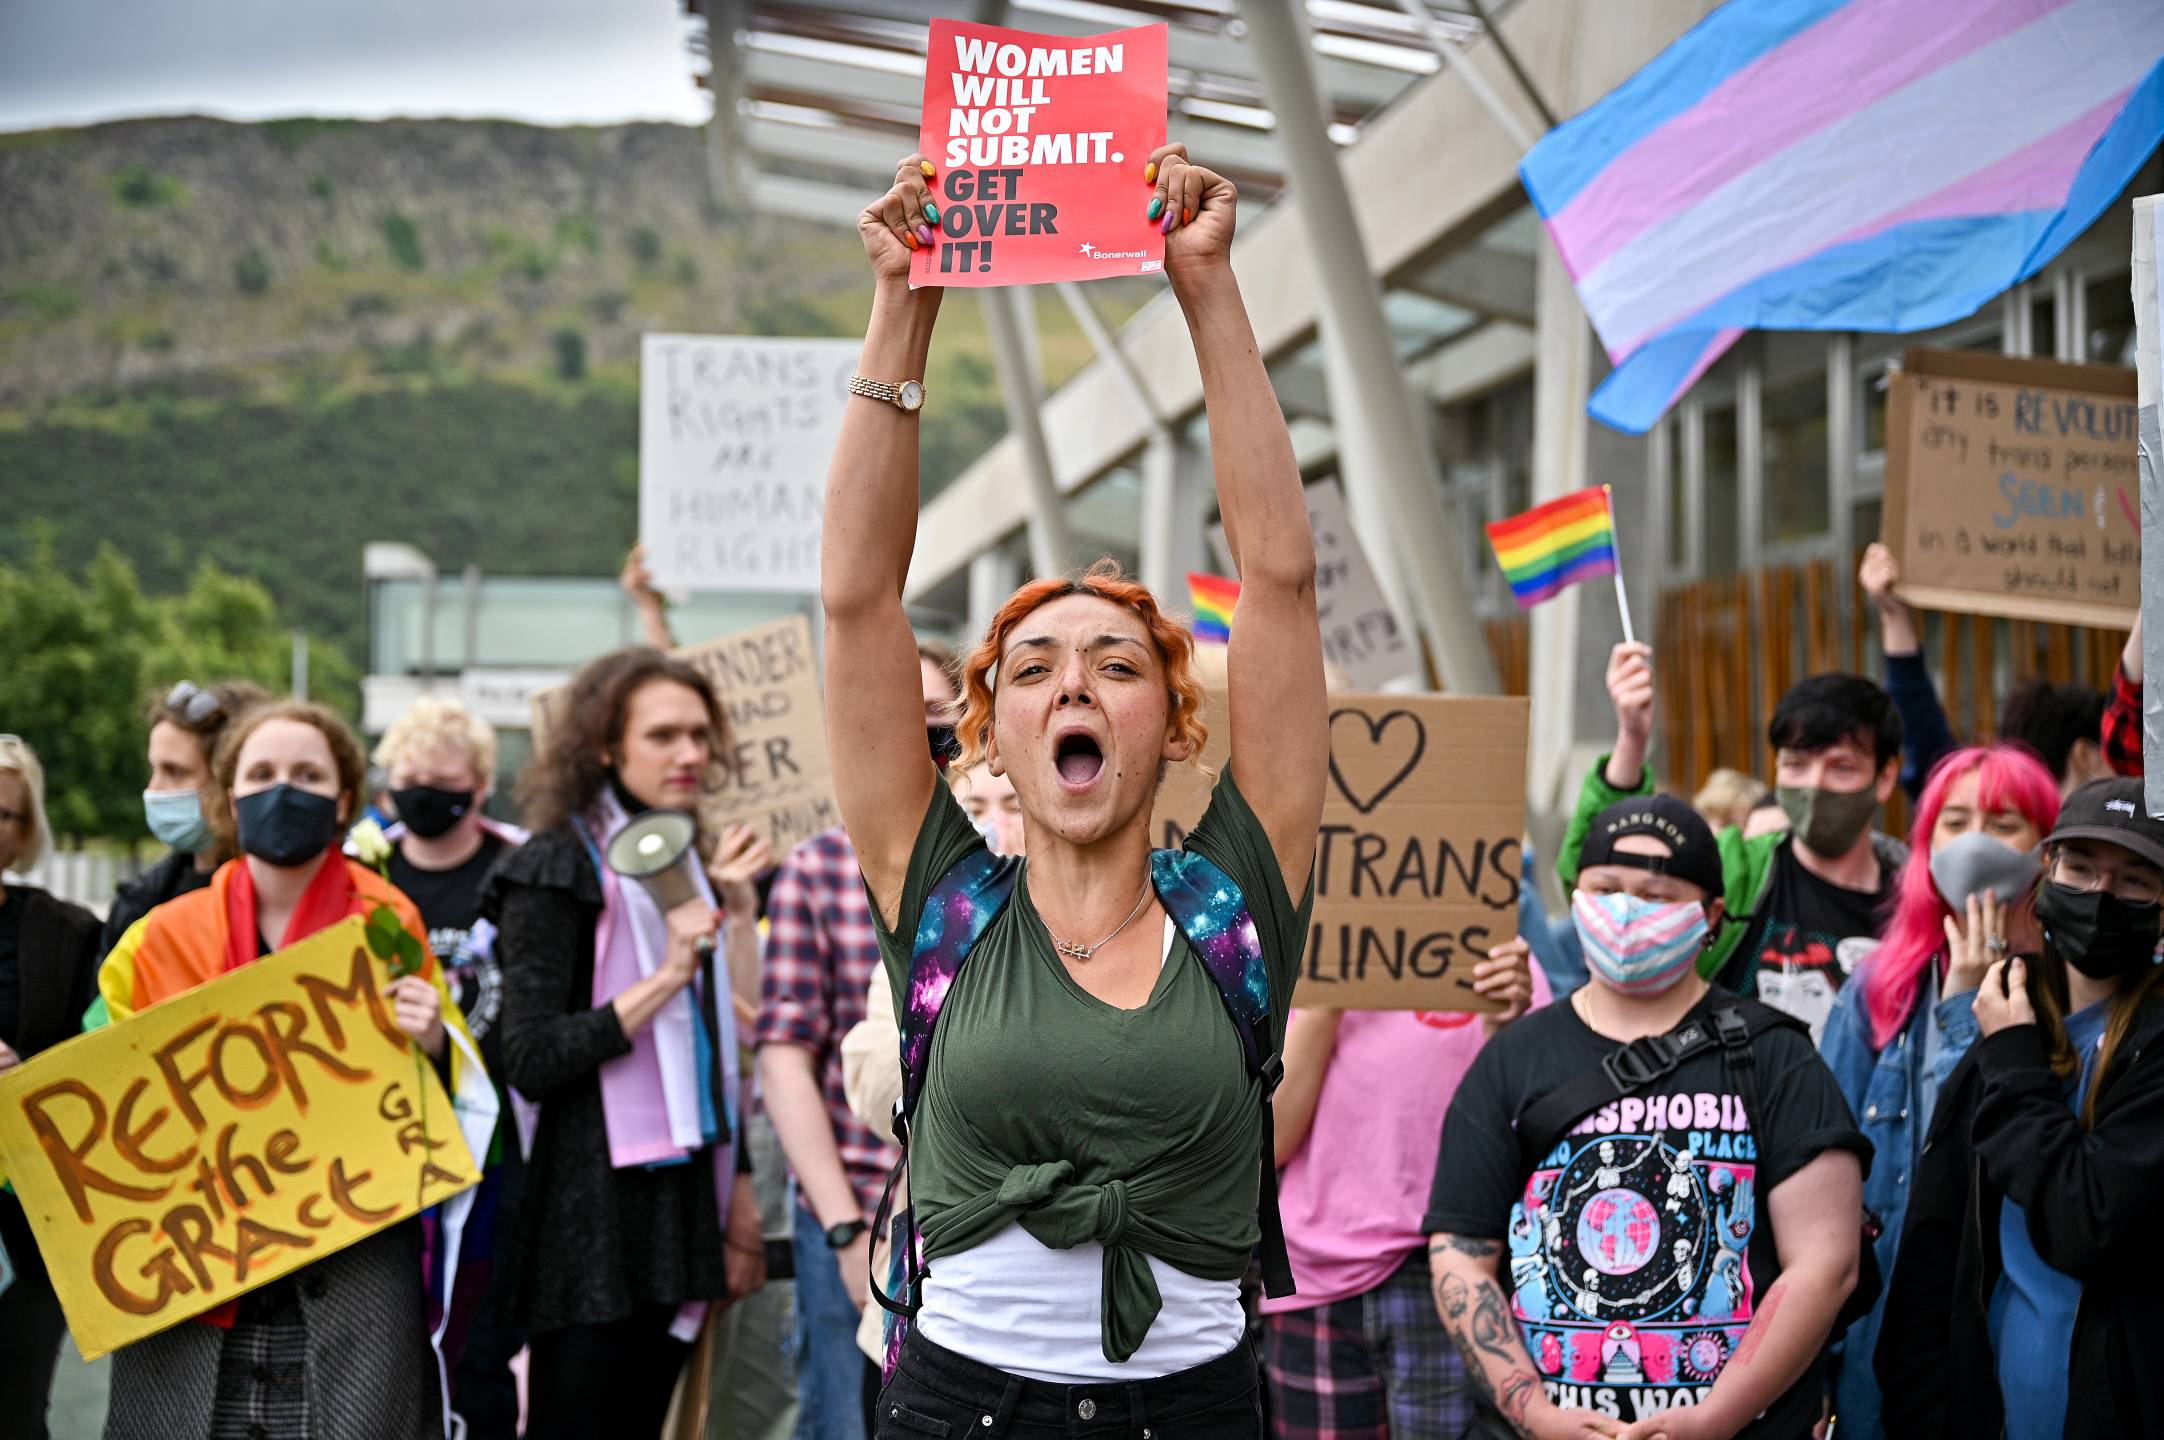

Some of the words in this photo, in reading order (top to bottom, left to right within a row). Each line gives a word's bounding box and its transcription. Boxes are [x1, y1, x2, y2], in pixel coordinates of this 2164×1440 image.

[954, 35, 1124, 77] WOMEN
[951, 73, 1051, 107] WILL
[948, 107, 1036, 136] NOT
[945, 132, 1124, 167] SUBMIT.
[944, 169, 1024, 201] GET
[941, 203, 1058, 238] OVER
[940, 241, 992, 273] IT!
[1093, 250, 1147, 259] Bonerwall
[656, 343, 822, 390] TRANS
[666, 387, 823, 443] RIGHTS
[709, 442, 781, 476] ARE
[1993, 473, 2085, 529] SEEN
[1607, 812, 1688, 847] BANGKOK
[1318, 824, 1521, 910] TRANS
[1300, 923, 1490, 991] LINGS
[21, 946, 411, 1225] REFORM
[1688, 1131, 1757, 1160] PLACE
[188, 1122, 317, 1226] the
[1543, 1381, 1620, 1420] THIS
